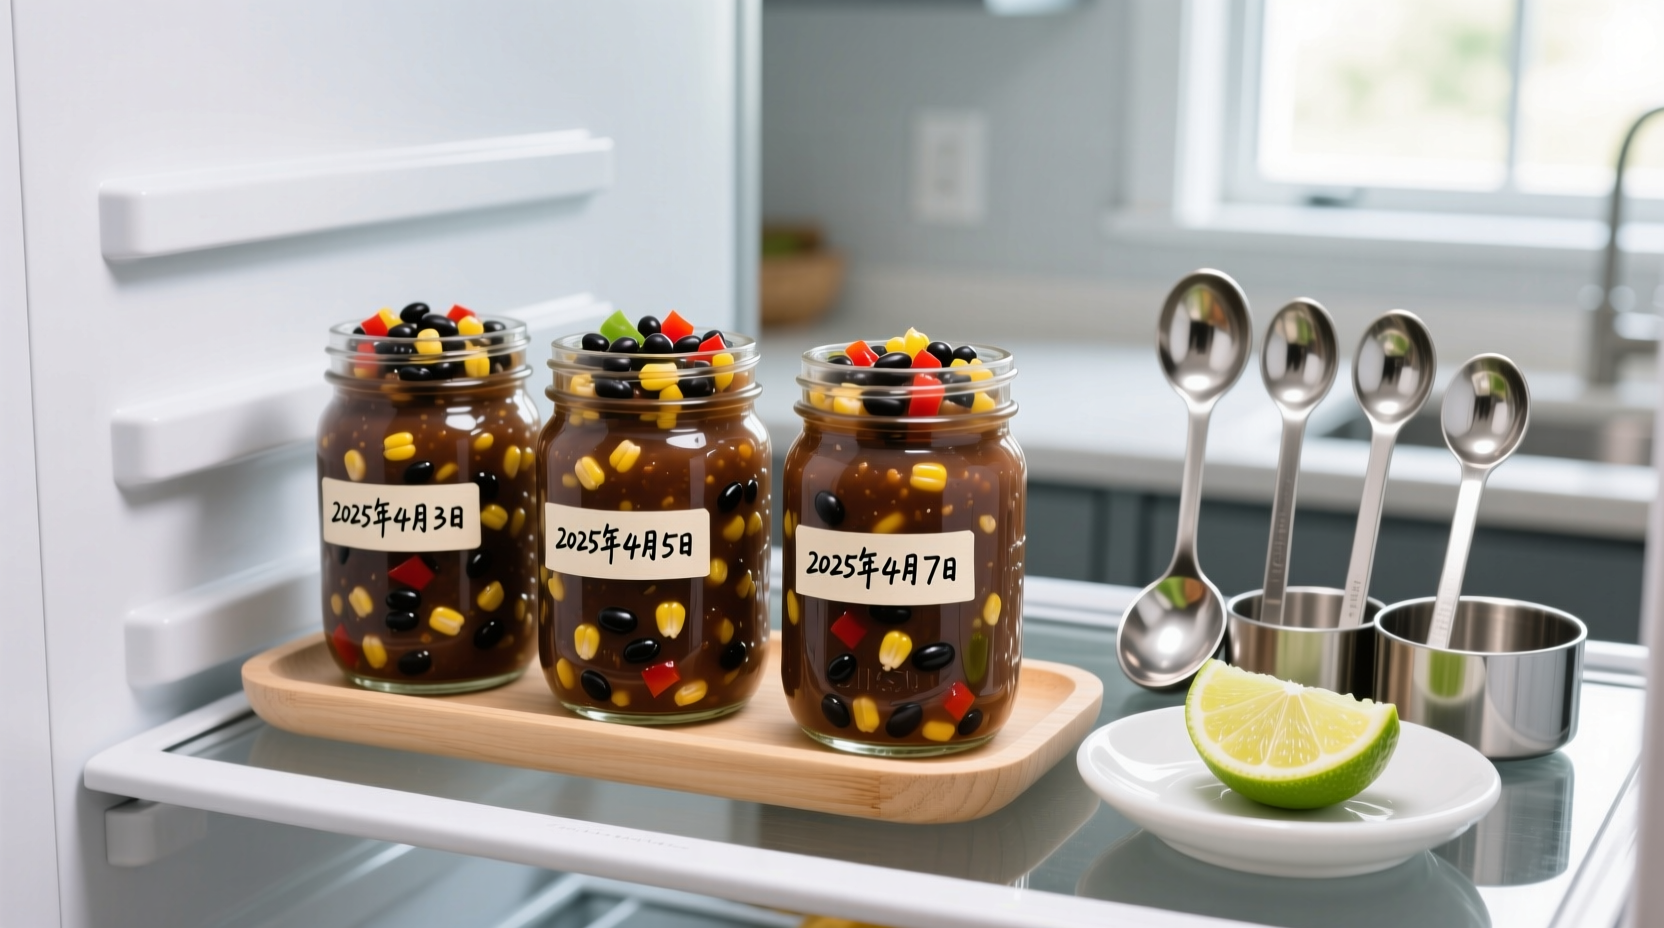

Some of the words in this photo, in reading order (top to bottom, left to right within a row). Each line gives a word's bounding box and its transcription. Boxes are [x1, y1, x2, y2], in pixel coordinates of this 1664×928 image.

[331, 497, 464, 539] 2025年4月3日
[555, 523, 693, 565] 2025年4月5日
[805, 546, 957, 590] 2025年4月7日
